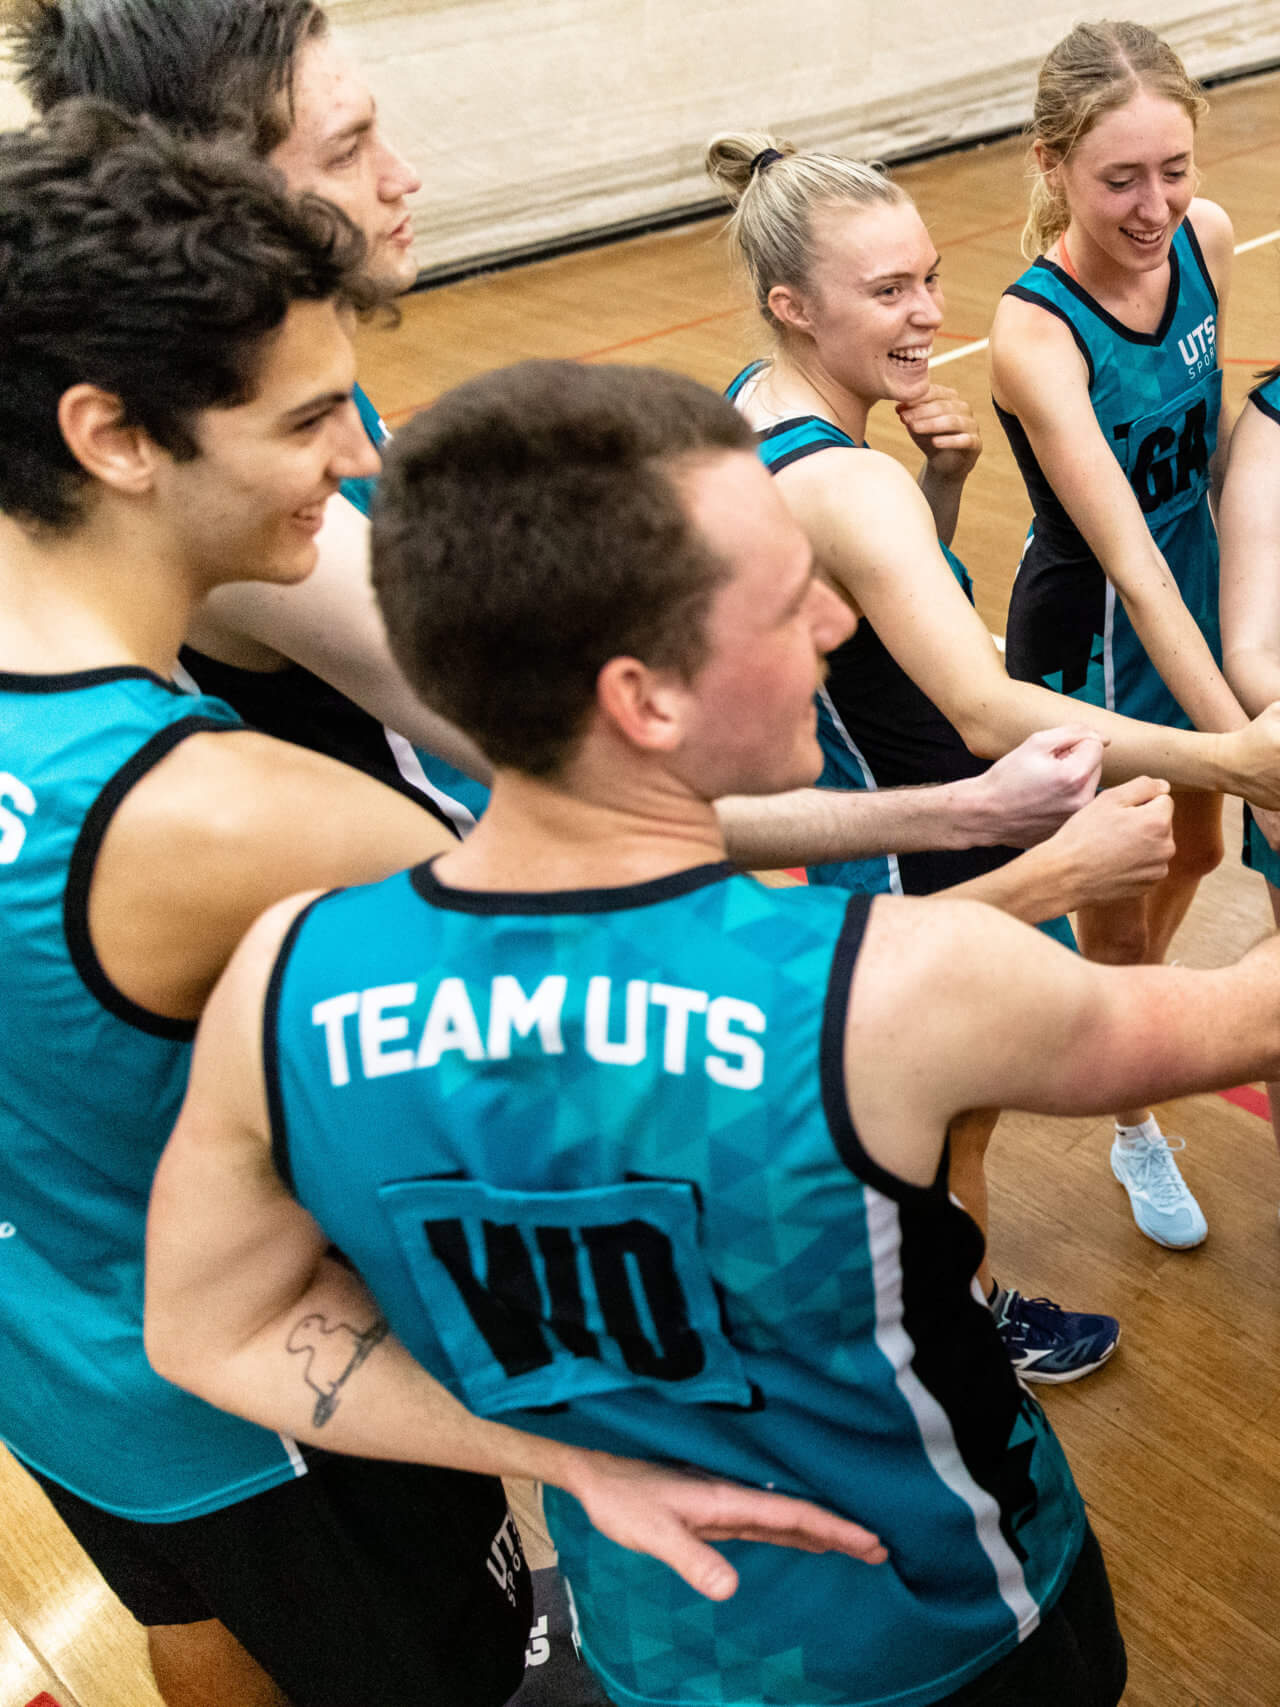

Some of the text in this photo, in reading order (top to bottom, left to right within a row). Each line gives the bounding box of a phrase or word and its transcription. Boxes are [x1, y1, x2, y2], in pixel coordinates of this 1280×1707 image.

[1177, 313, 1216, 366] UTS
[1131, 398, 1209, 514] GA
[312, 975, 767, 1091] TEAM UTS
[423, 1217, 706, 1382] WD
[487, 1509, 517, 1591] UT
